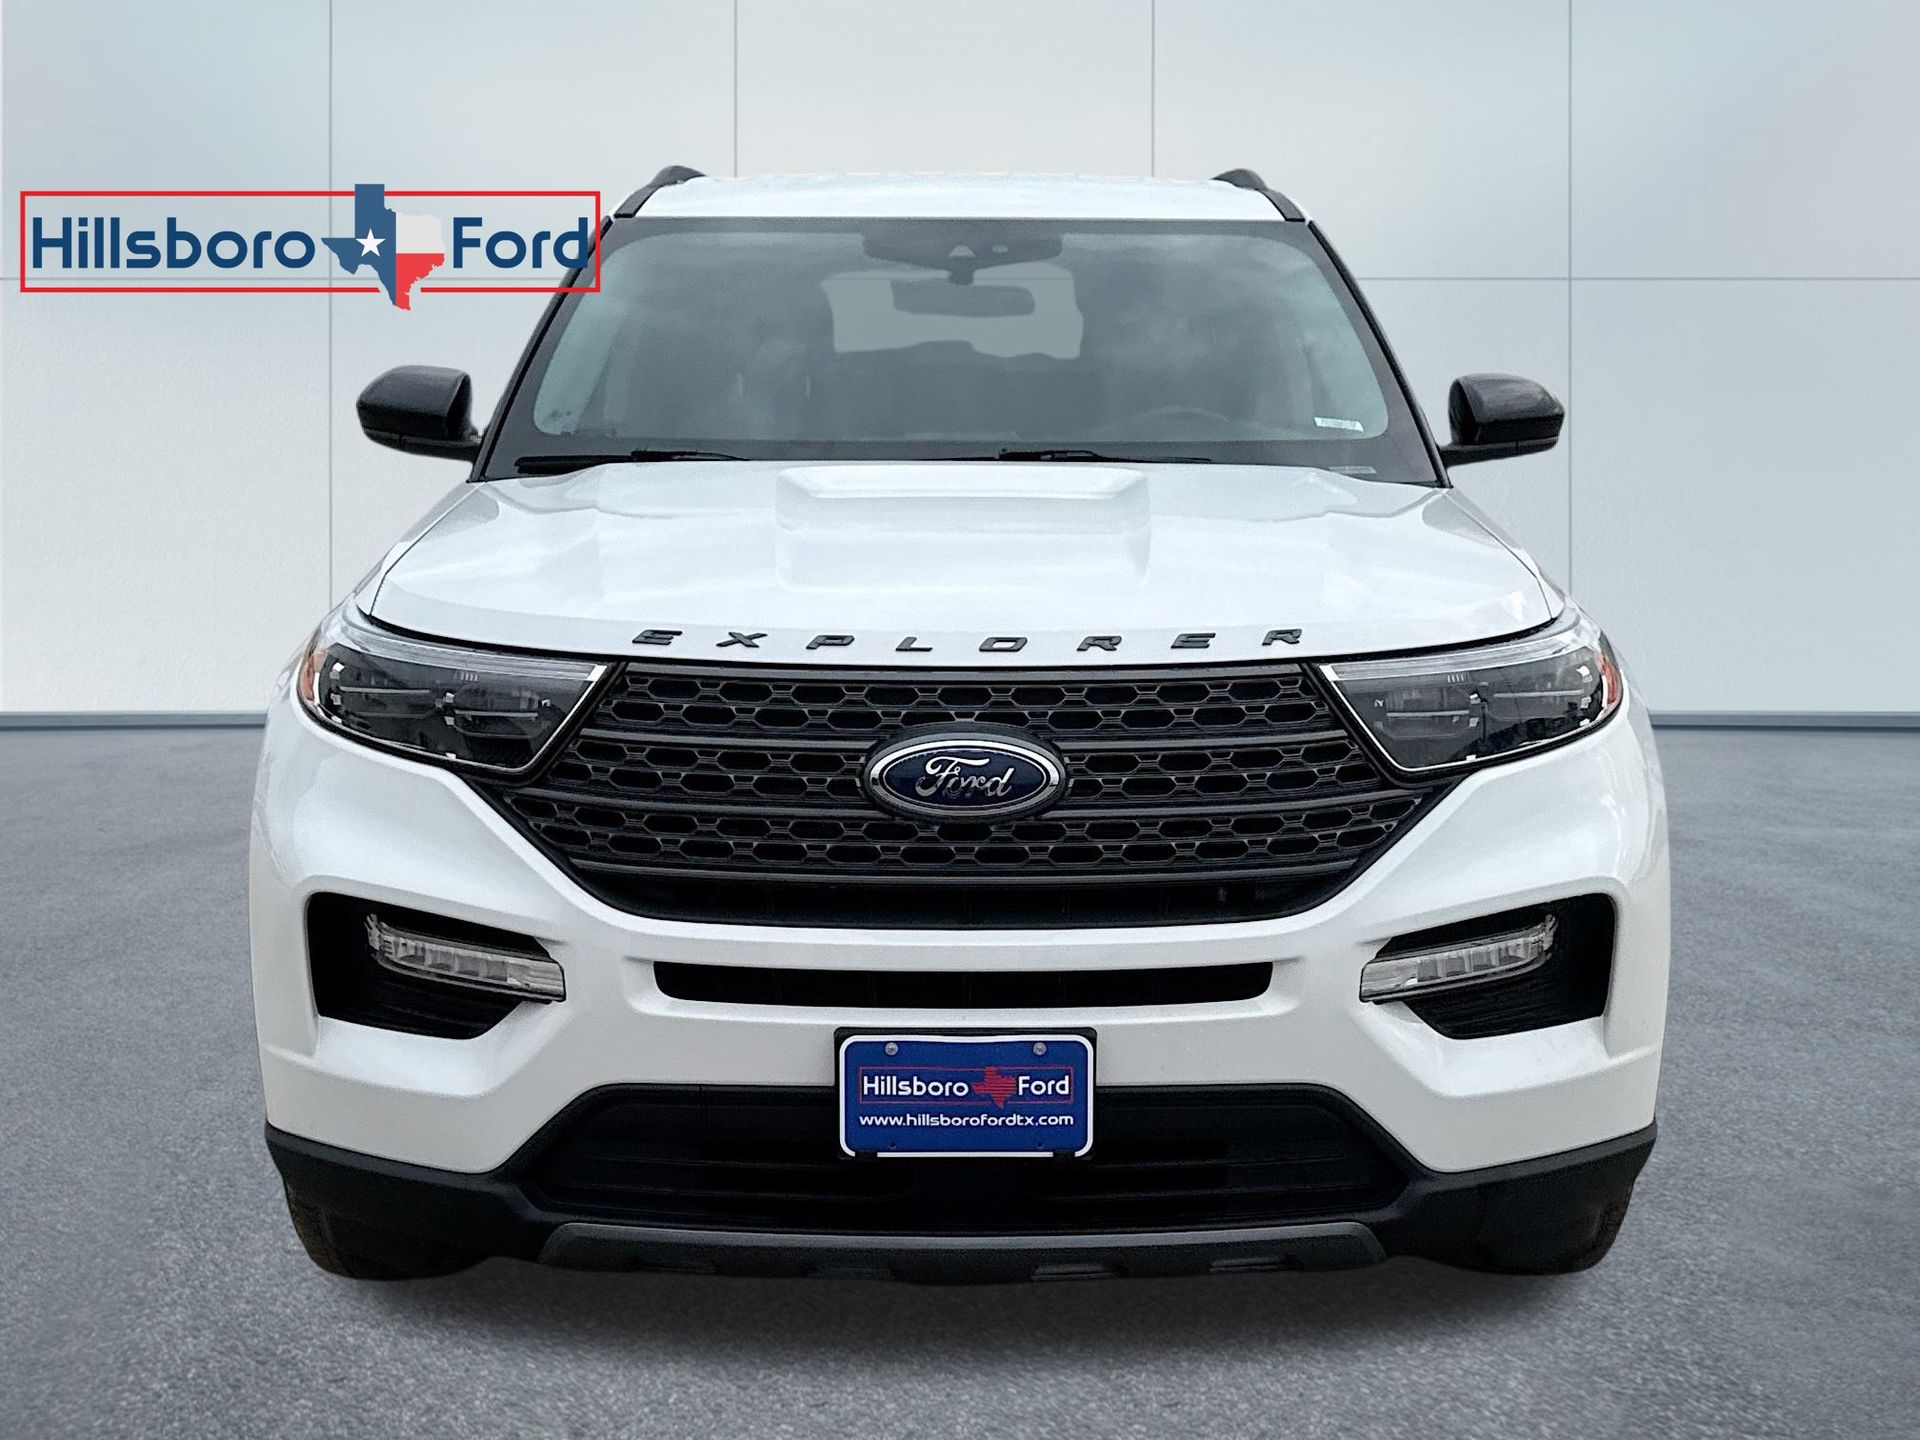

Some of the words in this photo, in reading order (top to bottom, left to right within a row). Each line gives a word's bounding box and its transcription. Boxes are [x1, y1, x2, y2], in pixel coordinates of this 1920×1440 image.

[631, 627, 1304, 654] EXPLORER
[914, 755, 1015, 800] Ford
[862, 1075, 969, 1096] Hillsboro
[1018, 1075, 1070, 1096] Ford
[859, 1113, 1074, 1127] www.hillsborofordtx.com
